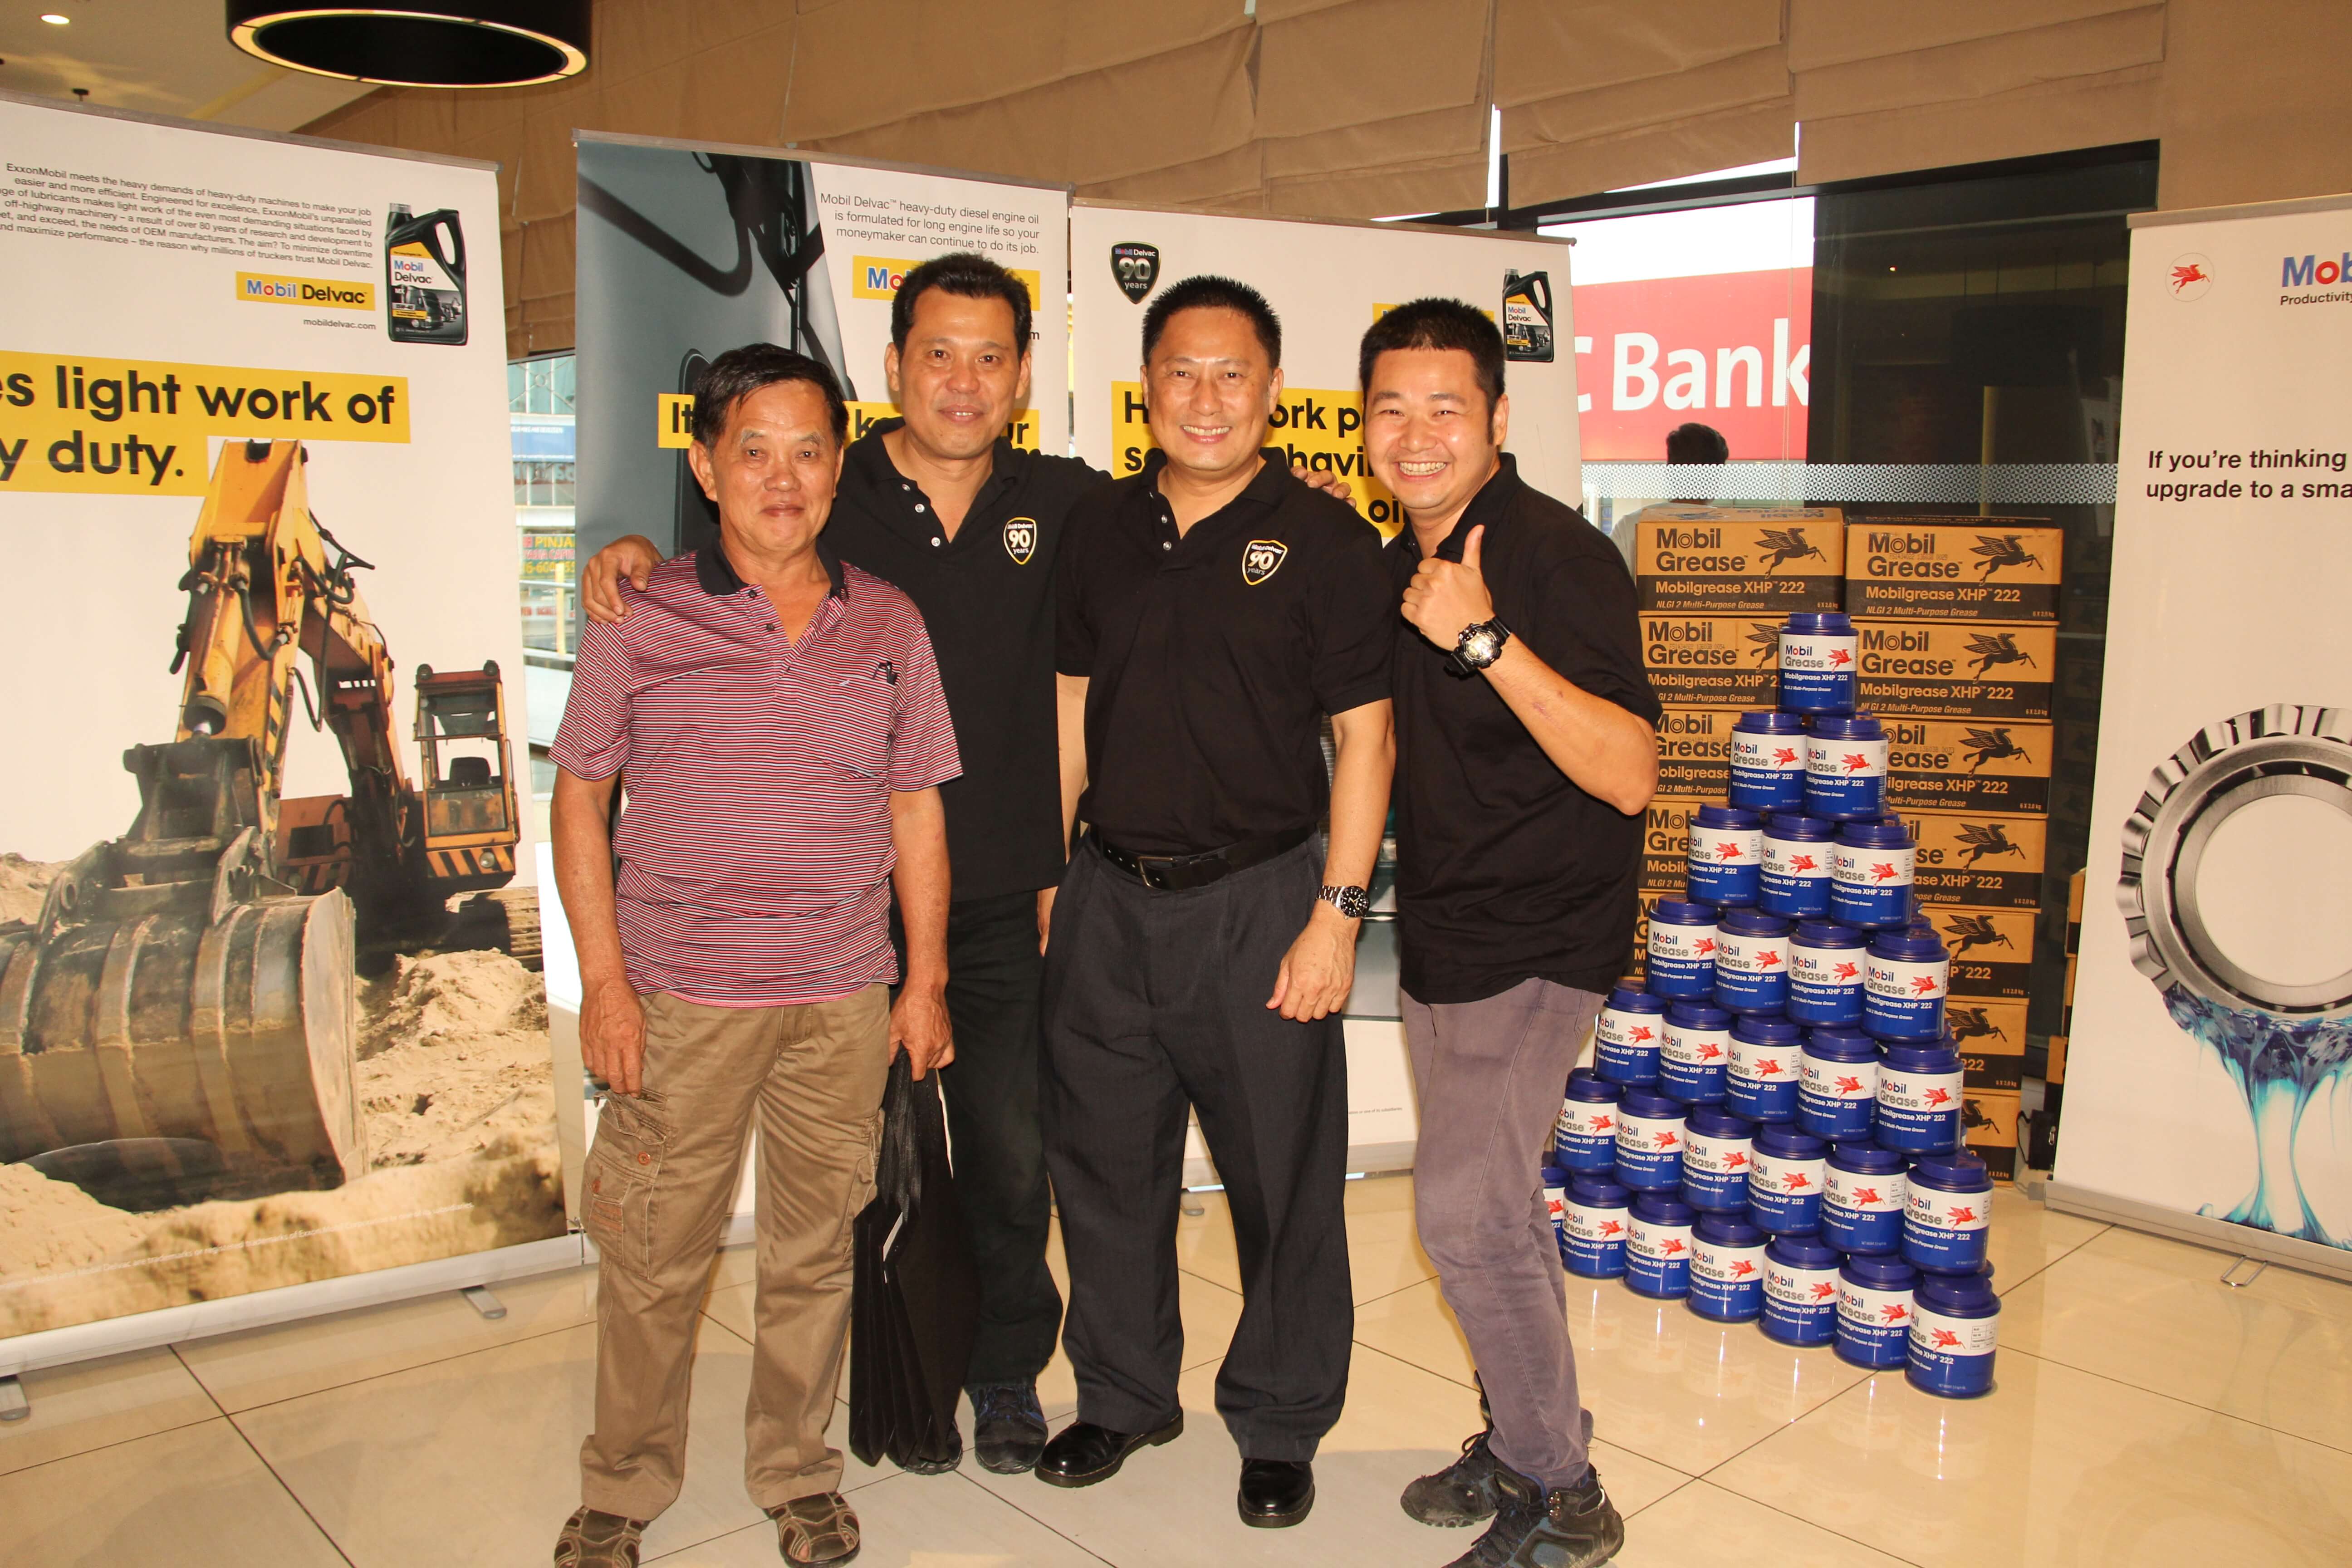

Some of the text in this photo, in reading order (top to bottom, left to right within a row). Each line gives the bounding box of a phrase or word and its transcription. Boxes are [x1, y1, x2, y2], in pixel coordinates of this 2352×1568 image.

[7, 163, 371, 217] ExxonMobil meets the heavy demands of heavy-duty machines to make your job
[15, 177, 371, 226] easier and more efficient. Engineered for excellence, ExxonMobil's unparalleled
[820, 193, 850, 206] Mobil
[900, 201, 956, 217] heavy-duty
[960, 207, 989, 219] diesel
[992, 212, 1024, 225] engine
[1028, 212, 1039, 224] oil
[18, 188, 29, 197] of
[31, 189, 80, 203] lubricants
[83, 197, 114, 207] makes
[118, 200, 137, 211] light
[141, 205, 163, 214] work
[166, 207, 176, 216] of
[178, 208, 192, 217] the
[196, 211, 216, 220] even
[219, 214, 240, 222] most
[243, 214, 291, 229] demanding
[294, 220, 334, 233] situations
[337, 225, 359, 235] faced
[362, 227, 372, 238] by
[835, 211, 843, 220] is
[847, 211, 903, 226] formulated
[906, 217, 920, 227] for
[923, 219, 945, 232] long
[948, 224, 983, 236] engine
[985, 225, 1000, 235] life
[1018, 230, 1039, 240] your
[836, 228, 1039, 254] moneymaker can continue to do its job.
[394, 260, 423, 271] Mobil
[1119, 257, 1151, 281] 90
[395, 272, 432, 284] Delvac
[247, 279, 365, 304] Mobil Delvac
[304, 318, 376, 330] mobildelvac.com
[1613, 318, 1810, 410] Bank
[56, 365, 181, 421] light
[195, 381, 333, 422] work
[347, 386, 394, 425] of
[48, 430, 184, 485] duty.
[2148, 451, 2163, 468] If
[2250, 449, 2347, 472] thinking
[2146, 480, 2242, 502] upgrade
[2250, 481, 2273, 498] to
[2281, 484, 2293, 498] a
[1009, 530, 1030, 548] 90
[1656, 528, 1721, 549] Mobil
[1868, 534, 1935, 554] Mobil
[1248, 551, 1274, 570] 90
[1656, 581, 1742, 595] Mobilgrease
[1779, 582, 1805, 594] 222
[1866, 586, 1954, 602] Mobilgrease
[1994, 589, 2020, 602] 222
[1683, 601, 1736, 610] Multi-Purpose
[1867, 606, 1885, 614] NLGI
[1894, 607, 1948, 616] Multi-Purpose
[1950, 608, 1978, 617] Grease
[1649, 621, 1712, 642] Mobil
[1863, 630, 1929, 651] Mobil
[1785, 645, 1812, 656] Mobil
[1785, 656, 1823, 668] Grease
[1648, 673, 1731, 688] Mobilgrease
[1784, 672, 1820, 681] Mobilgrease
[1861, 683, 1948, 699] Mobilgrease
[1987, 687, 2014, 700] 222
[1653, 931, 1678, 945] Mobil
[1653, 943, 1688, 956] Grease
[1652, 958, 1685, 969] Mobilgrease
[1868, 966, 1894, 982] Mobil
[1868, 978, 1905, 995] Grease
[1867, 994, 1902, 1008] Mobilgrease
[1881, 1078, 1906, 1094] Mobil
[1880, 1090, 1918, 1107] Grease
[1879, 1106, 1915, 1120] Mobilgrease
[1768, 1269, 1793, 1288] Mobil
[1768, 1281, 1804, 1301] Grease
[1766, 1296, 1801, 1313] Mobilgrease
